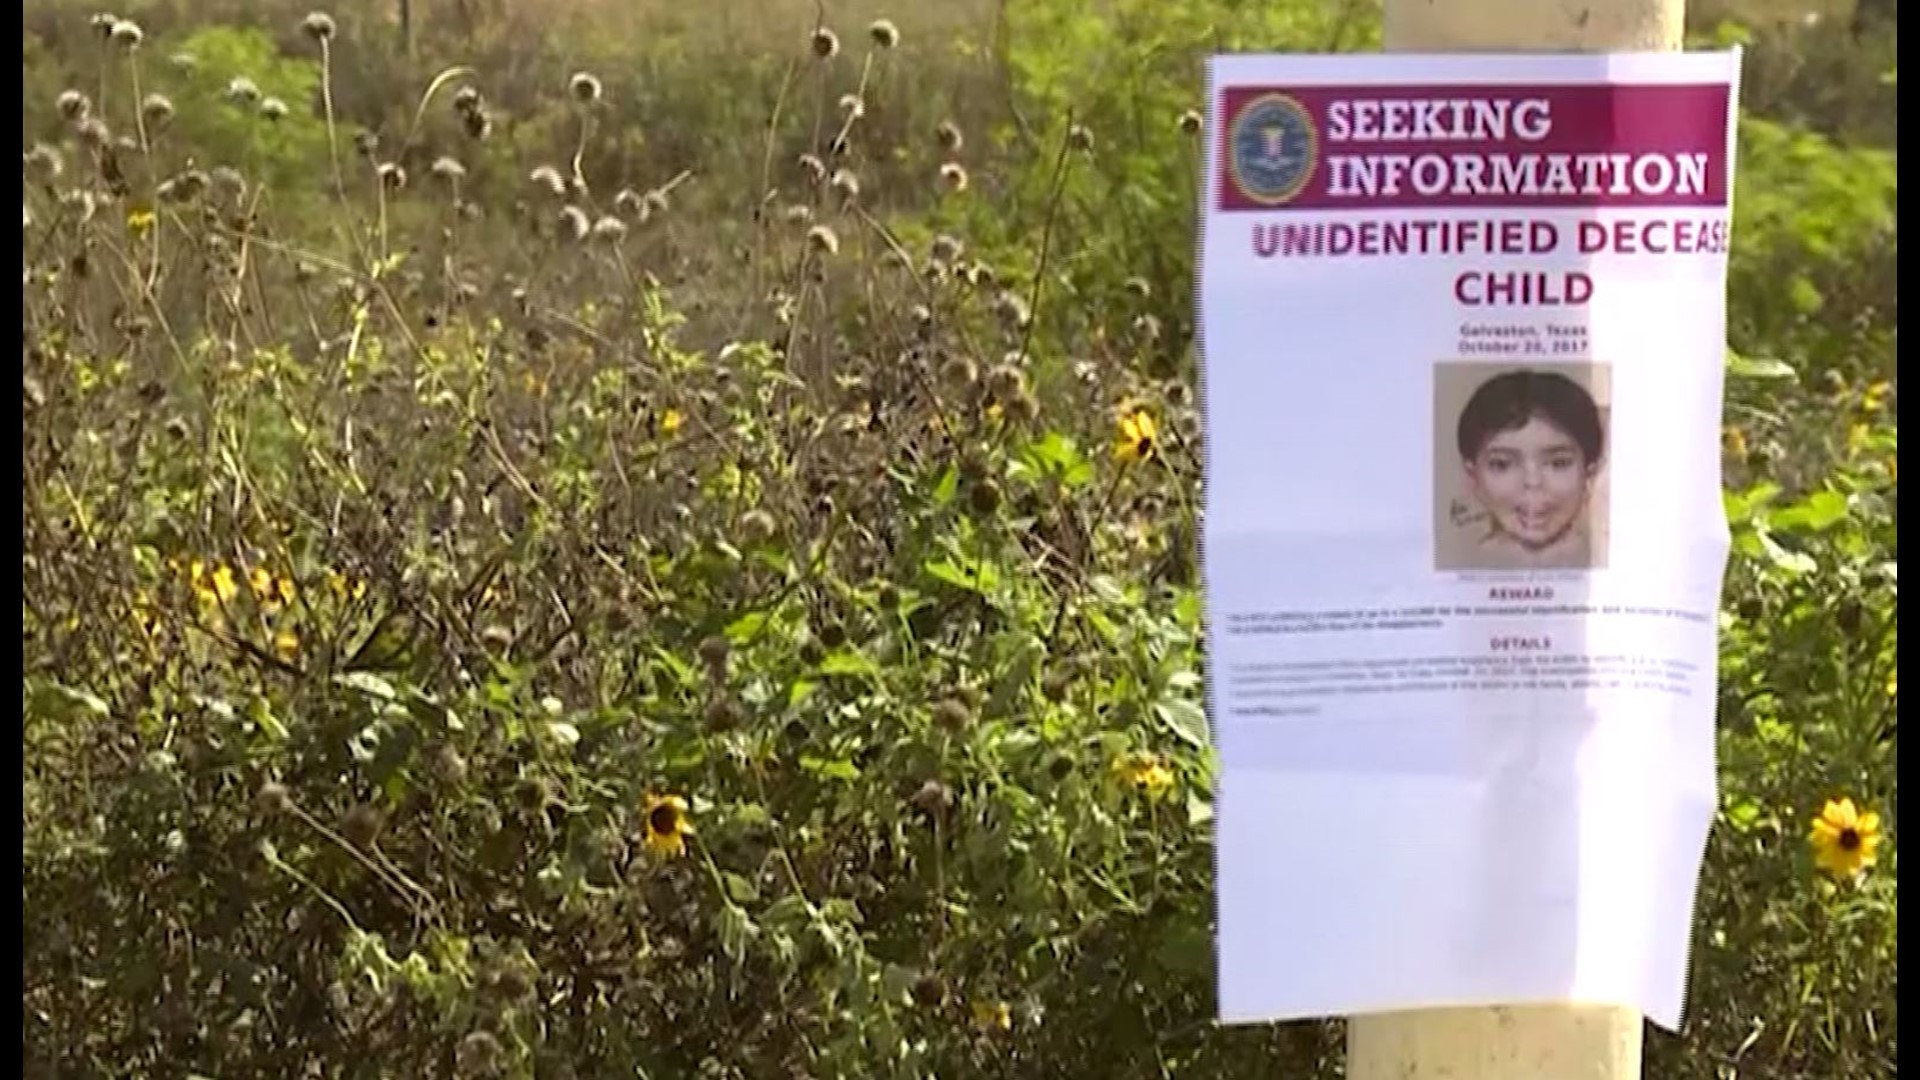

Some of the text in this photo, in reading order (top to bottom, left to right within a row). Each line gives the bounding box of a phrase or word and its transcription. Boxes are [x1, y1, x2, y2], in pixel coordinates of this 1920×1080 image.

[1327, 99, 1552, 141] SEEKING
[1327, 153, 1708, 196] INFORMATION
[1252, 220, 1559, 257] UNIDENTIFIED
[1454, 271, 1595, 305] CHILD
[1547, 324, 1588, 337] Texas
[1458, 340, 1519, 353] October
[1552, 340, 1588, 352] 2017
[1489, 587, 1554, 600] REWARD
[1489, 637, 1552, 650] DETAILS
